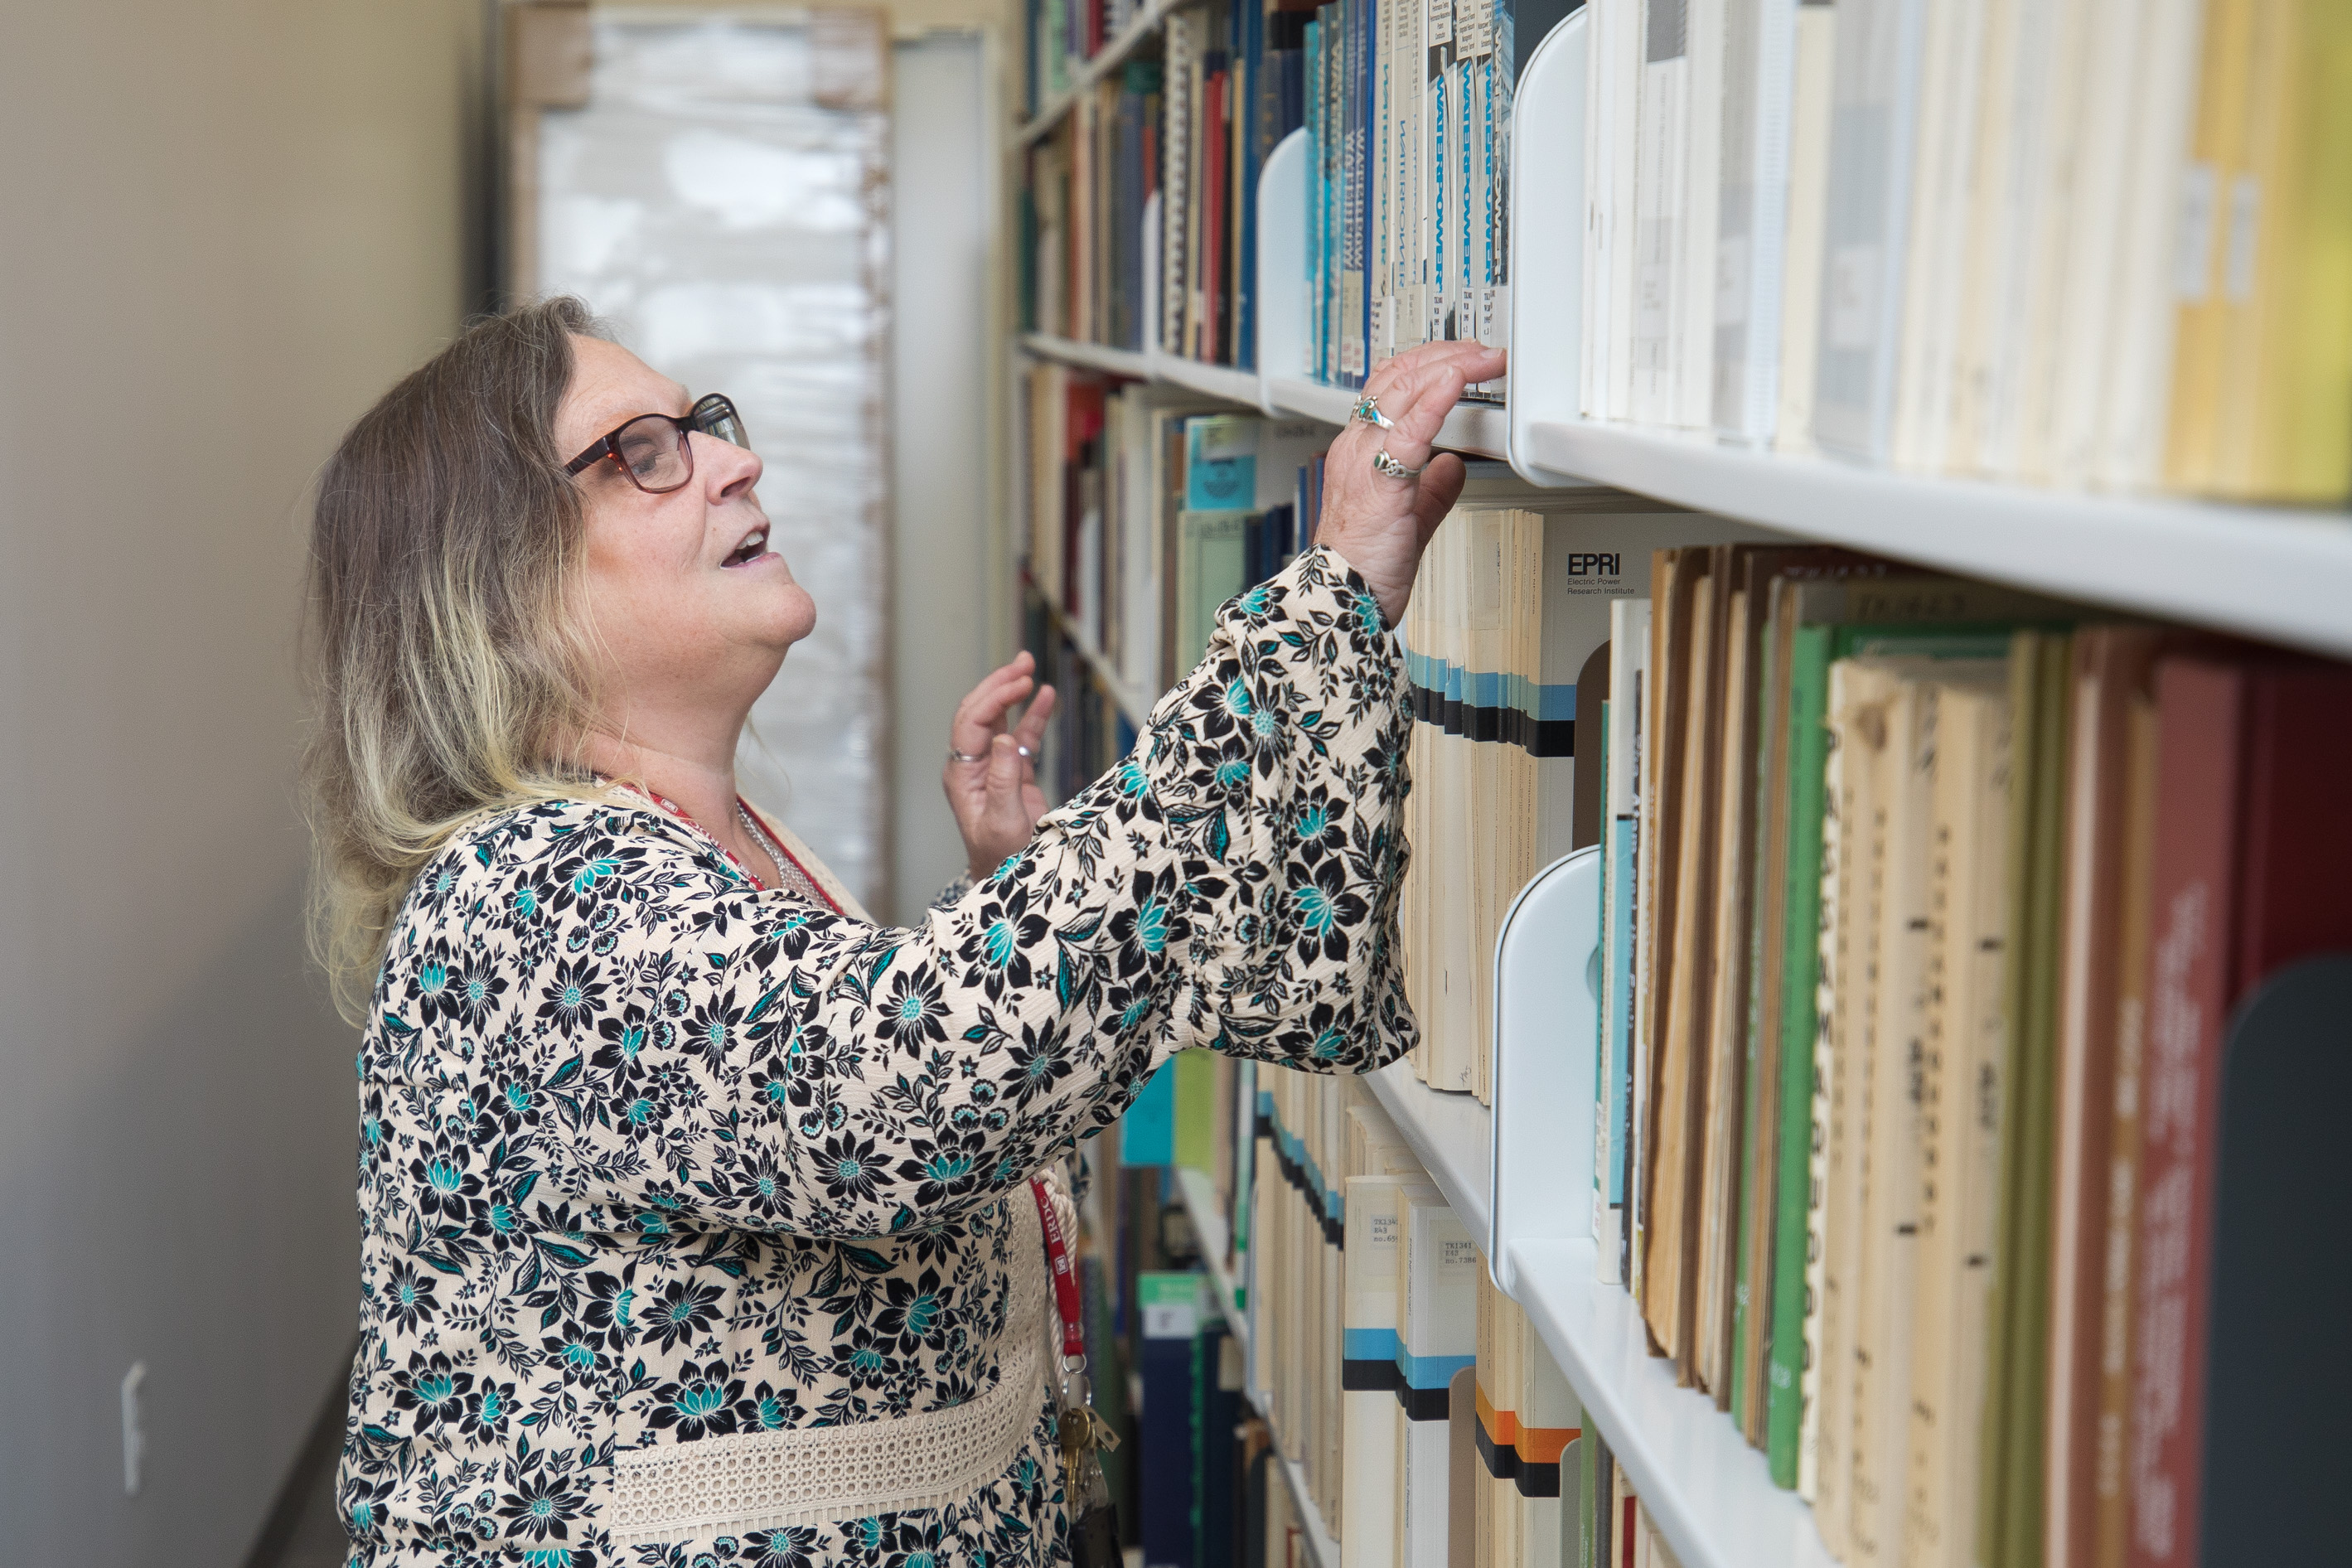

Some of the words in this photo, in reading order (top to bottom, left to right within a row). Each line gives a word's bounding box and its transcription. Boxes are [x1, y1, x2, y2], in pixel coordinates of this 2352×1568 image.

[1398, 119, 1406, 288] WATERPOWER
[1435, 74, 1445, 286] WATERPOWER
[1567, 553, 1620, 575] EPRI
[1041, 1196, 1062, 1244] ERDC
